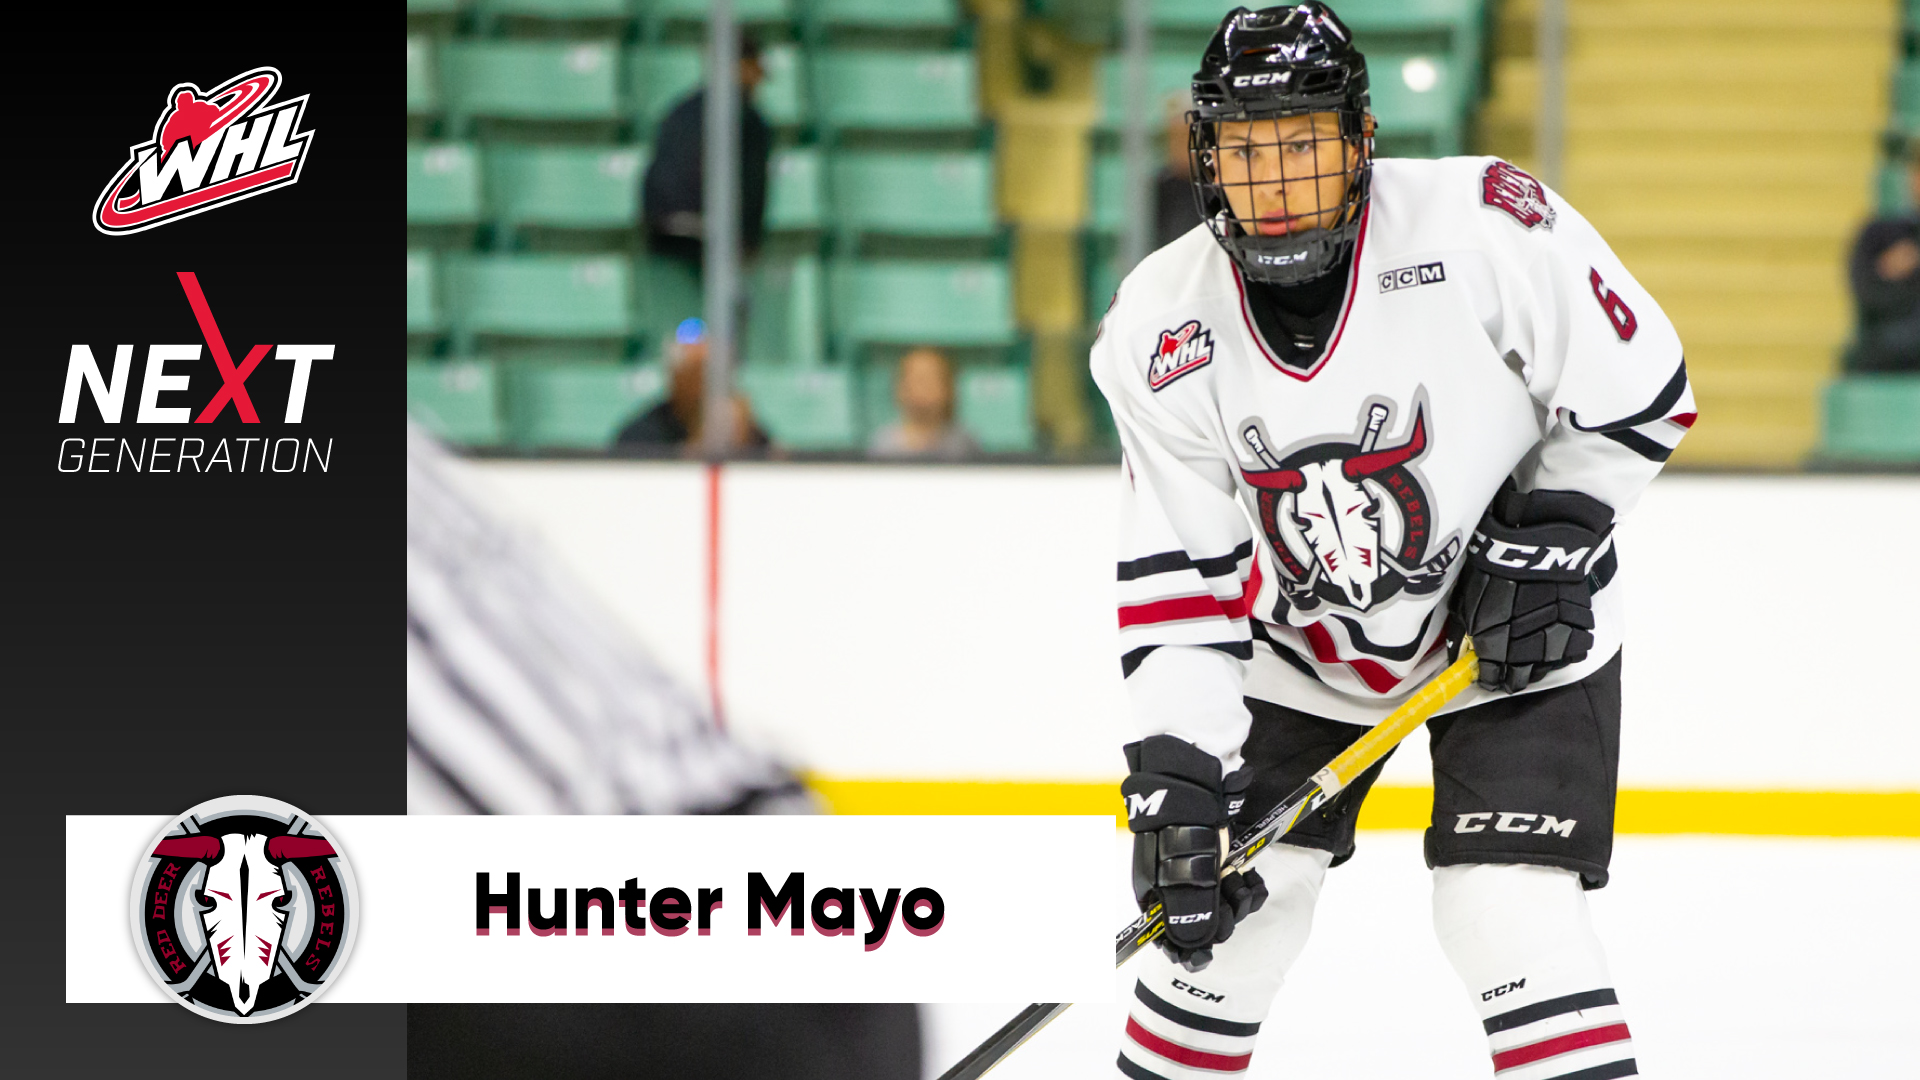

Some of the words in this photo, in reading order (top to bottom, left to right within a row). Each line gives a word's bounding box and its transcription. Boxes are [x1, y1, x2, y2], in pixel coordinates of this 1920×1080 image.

[1232, 71, 1292, 88] CCM
[1378, 262, 1446, 293] CCM
[1588, 266, 1639, 343] 6
[1154, 330, 1212, 377] WHL
[1387, 472, 1419, 561] REBELS
[1467, 529, 1592, 571] CCM
[1453, 811, 1578, 838] CCM
[1168, 911, 1213, 925] CCM
[1170, 977, 1226, 1004] CCM
[1479, 977, 1527, 1002] CCM
